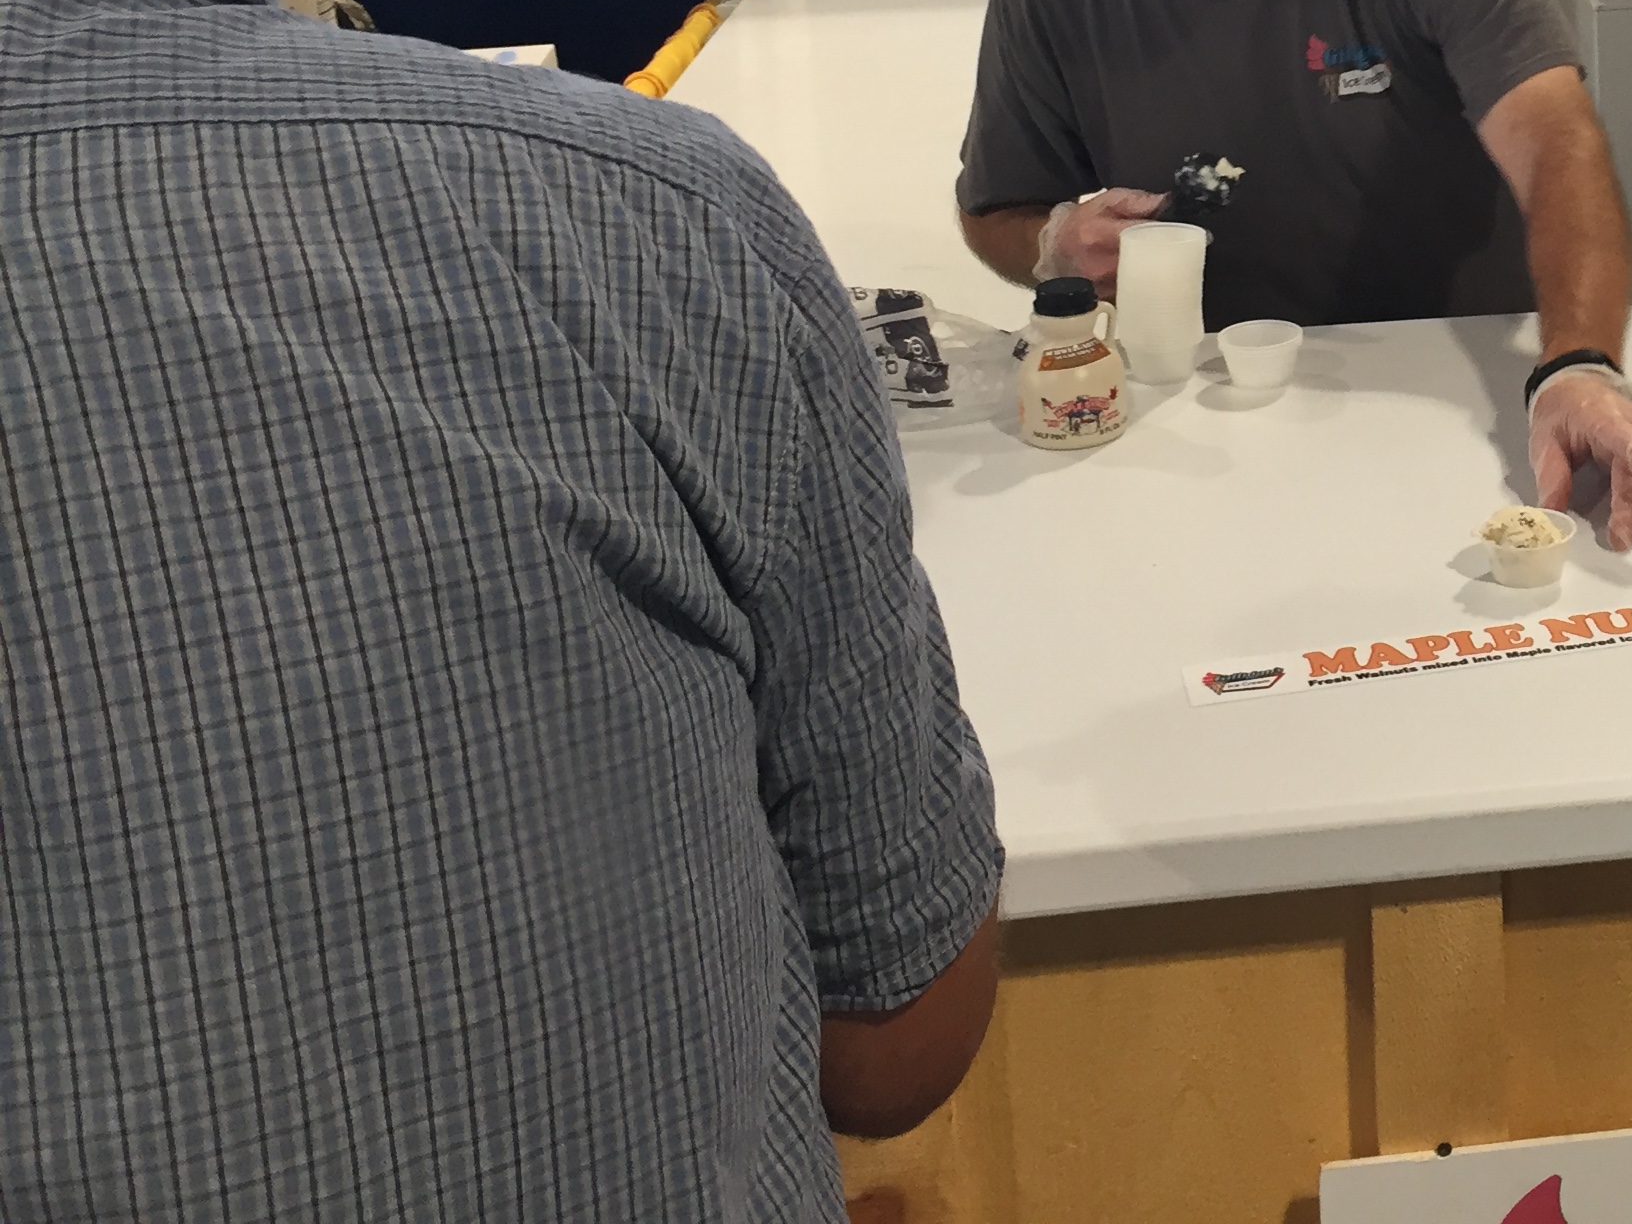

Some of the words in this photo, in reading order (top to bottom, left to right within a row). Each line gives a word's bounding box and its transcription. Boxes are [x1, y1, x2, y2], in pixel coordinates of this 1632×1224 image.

[1302, 623, 1534, 678] MAPLE
[1308, 675, 1352, 687] Fresh
[1355, 666, 1418, 680] Walnuts
[1421, 658, 1469, 670] mixed
[1506, 646, 1551, 659] Maple
[1555, 637, 1616, 652] flavored
